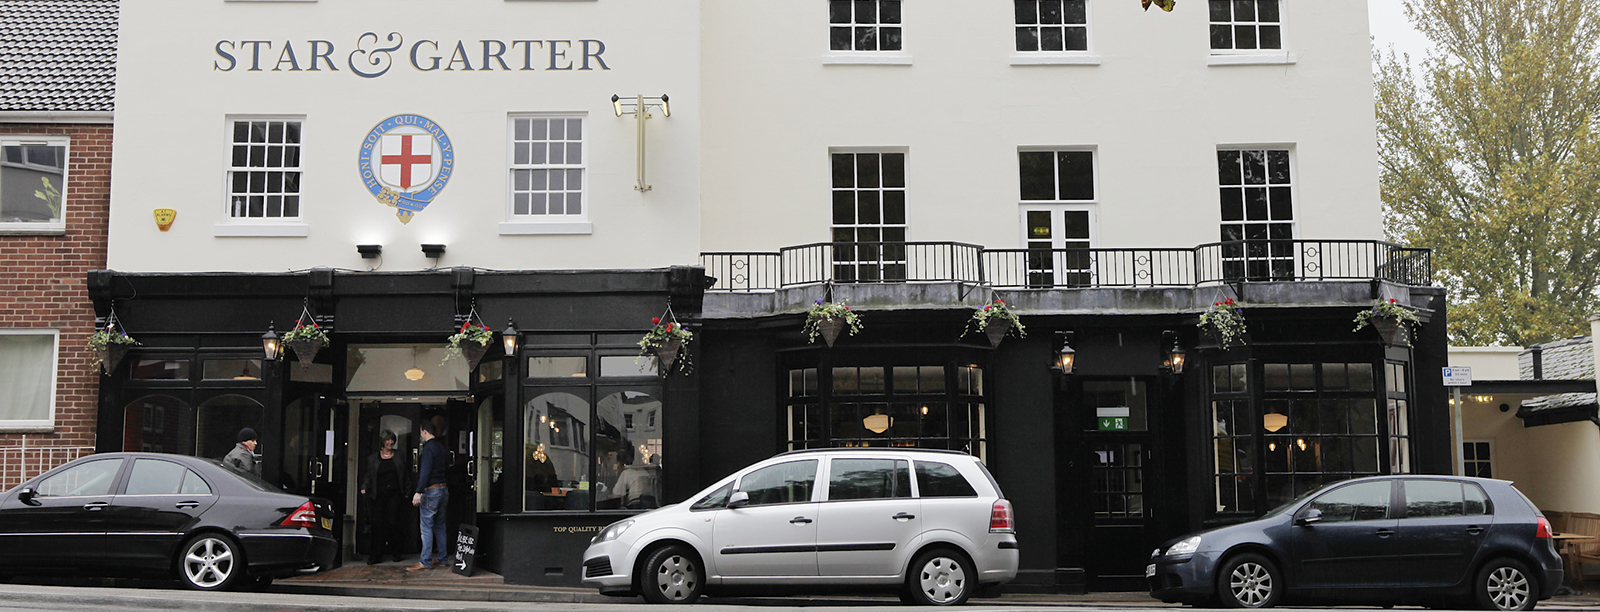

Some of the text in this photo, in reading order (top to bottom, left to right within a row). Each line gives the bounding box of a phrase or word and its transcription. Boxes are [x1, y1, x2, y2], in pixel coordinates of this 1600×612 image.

[213, 31, 611, 79] STAR & GARTER
[394, 115, 418, 125] QUI
[423, 120, 443, 142] MAL
[364, 123, 386, 151] SOIT
[361, 157, 378, 189] HONI
[428, 159, 453, 195] PENSE
